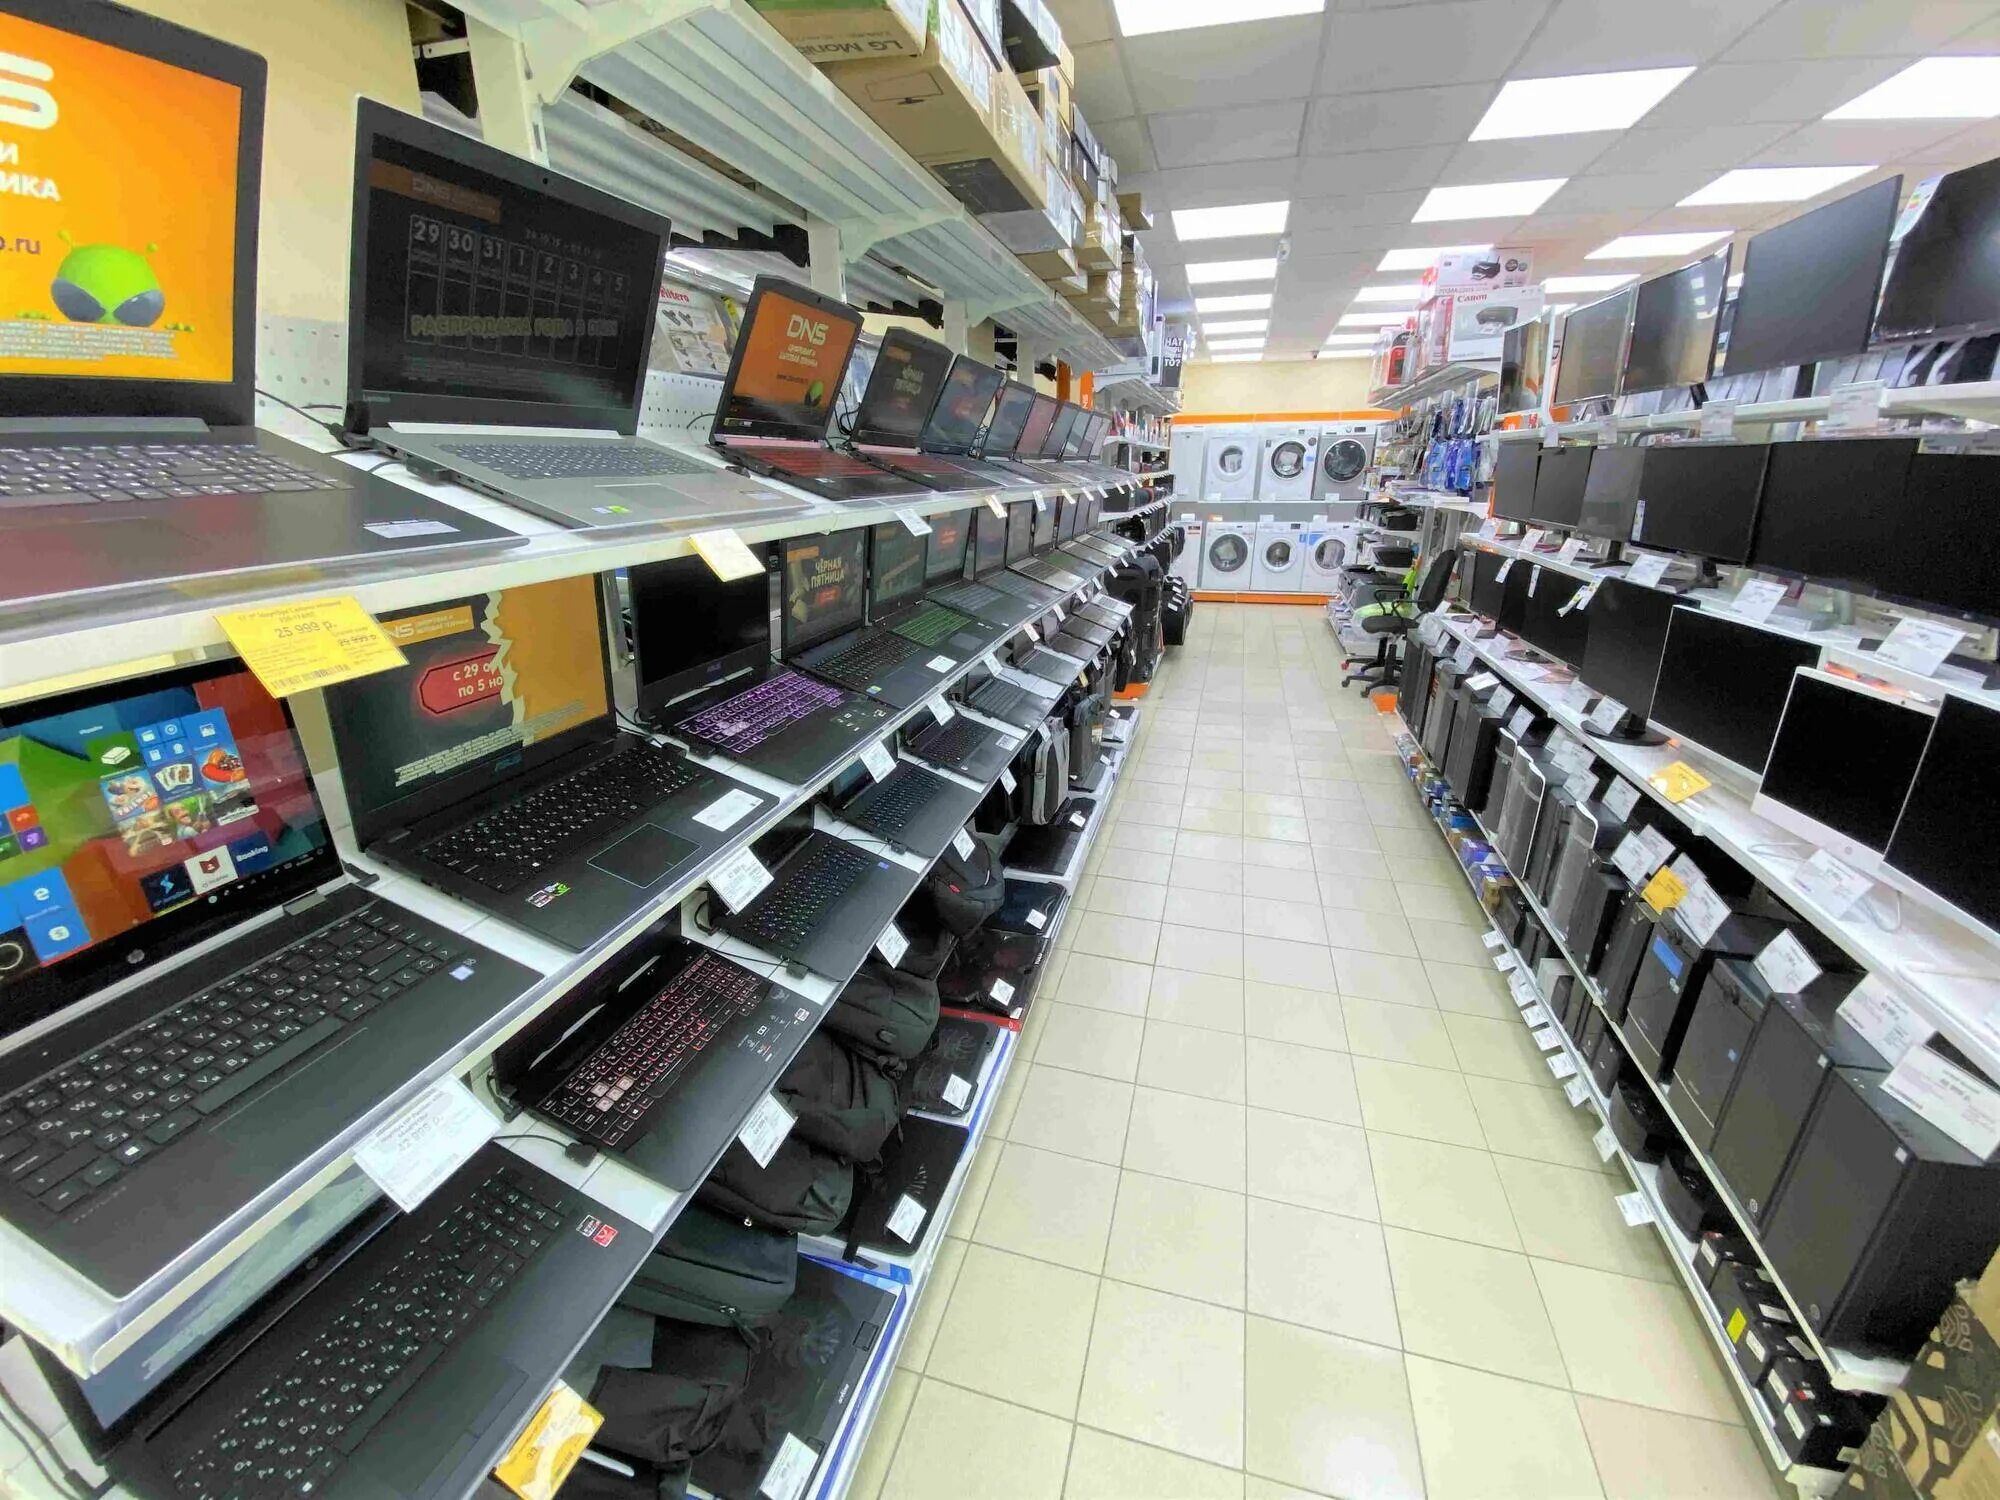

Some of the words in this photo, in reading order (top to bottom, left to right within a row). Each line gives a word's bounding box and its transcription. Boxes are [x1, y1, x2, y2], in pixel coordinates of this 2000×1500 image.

[868, 40, 904, 51] LG
[413, 221, 441, 244] 29
[449, 229, 474, 253] 30
[482, 239, 503, 261] 31
[543, 256, 555, 275] 2
[1456, 294, 1488, 303] Canon
[786, 314, 829, 346] DNS
[811, 569, 845, 589] ПЯТНИЦА
[274, 626, 294, 638] 25
[295, 621, 320, 634] 999
[463, 663, 479, 679] 29
[457, 685, 474, 698] по
[477, 678, 485, 691] 5
[236, 845, 268, 862] Booking
